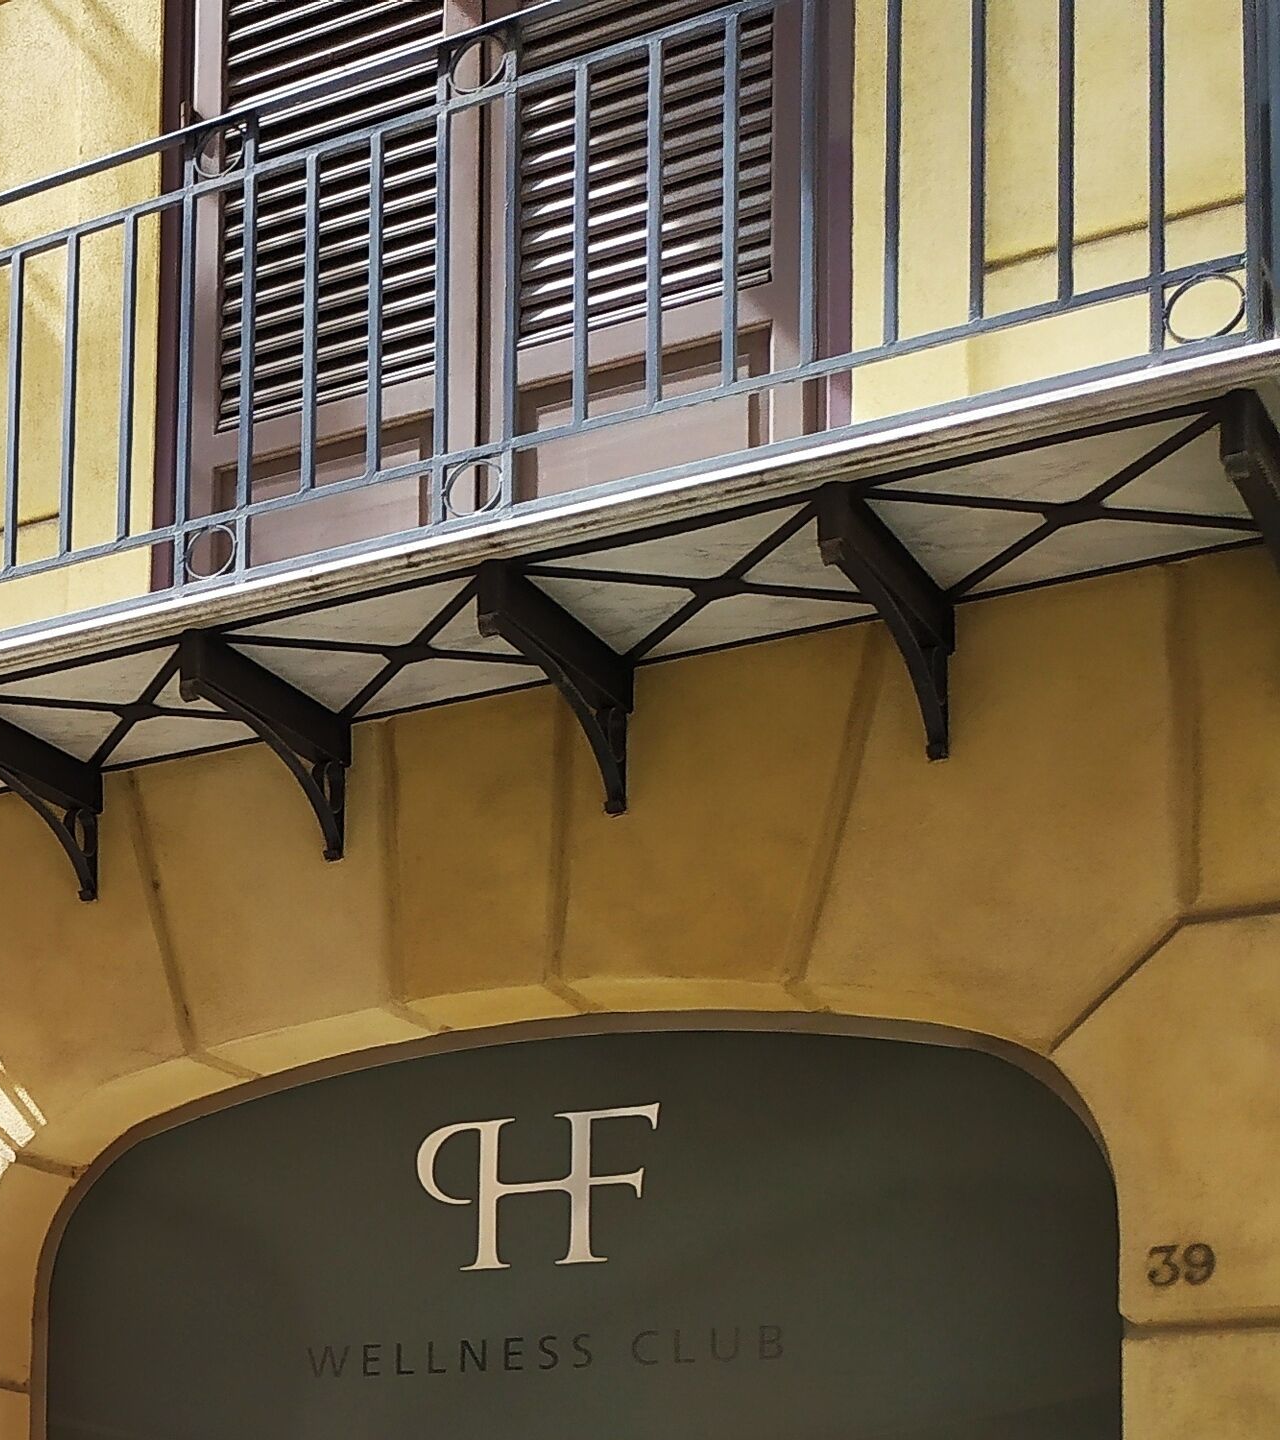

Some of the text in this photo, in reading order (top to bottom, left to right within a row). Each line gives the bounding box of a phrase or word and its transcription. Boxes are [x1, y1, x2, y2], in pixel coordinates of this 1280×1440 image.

[1146, 1242, 1216, 1286] 39
[307, 1324, 785, 1378] WELLNESS CLUB
